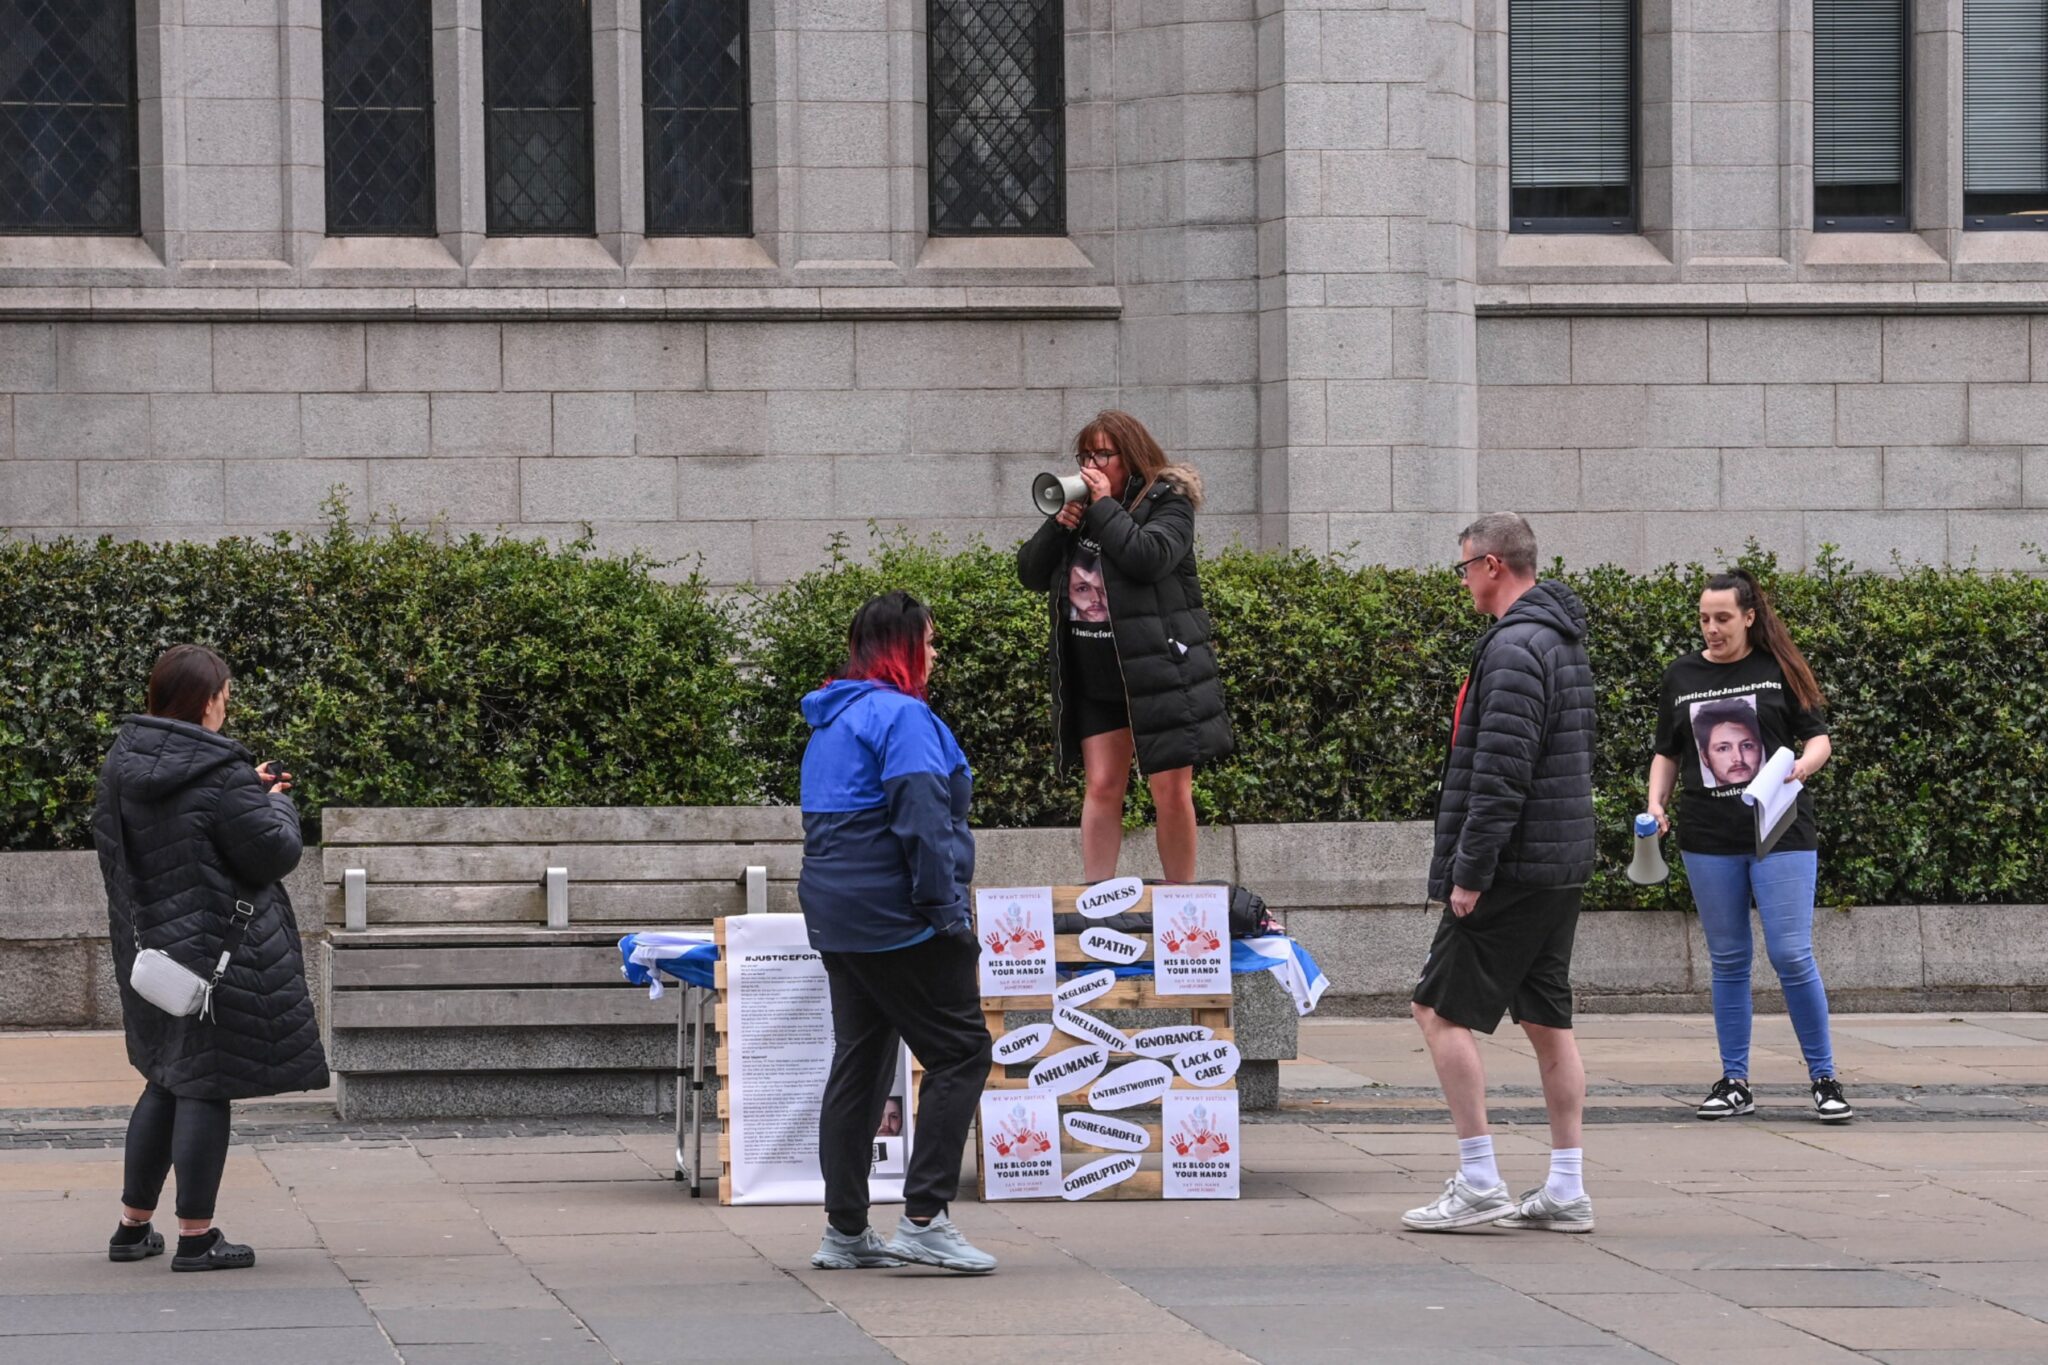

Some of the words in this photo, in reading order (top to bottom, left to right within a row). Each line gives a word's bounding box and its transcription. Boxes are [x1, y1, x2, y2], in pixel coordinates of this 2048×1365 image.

[1711, 788, 1746, 798] #Justice
[1082, 885, 1137, 910] LAZINESS
[1088, 936, 1137, 957] APATHY
[992, 968, 1015, 976] YOUR
[1016, 967, 1044, 975] HANDS
[1005, 959, 1033, 967] BLOOD
[1034, 958, 1046, 966] ON
[1058, 977, 1109, 1002] NEGLIGENCE
[1058, 1009, 1127, 1051] UNRELIABILITY
[1135, 1030, 1206, 1049] IGNORANCE
[1000, 1033, 1040, 1056] SLOPPY
[1034, 1051, 1103, 1086] INHUMANE
[1181, 1053, 1210, 1069] LACK
[1213, 1047, 1229, 1059] OF
[1195, 1064, 1226, 1081] CARE
[1092, 1076, 1165, 1100] UNTRUSTWORTHY
[1069, 1118, 1143, 1144] DISREGARDFUL
[1064, 1158, 1136, 1192] CORRUPTION
[1200, 1170, 1227, 1178] HANDS
